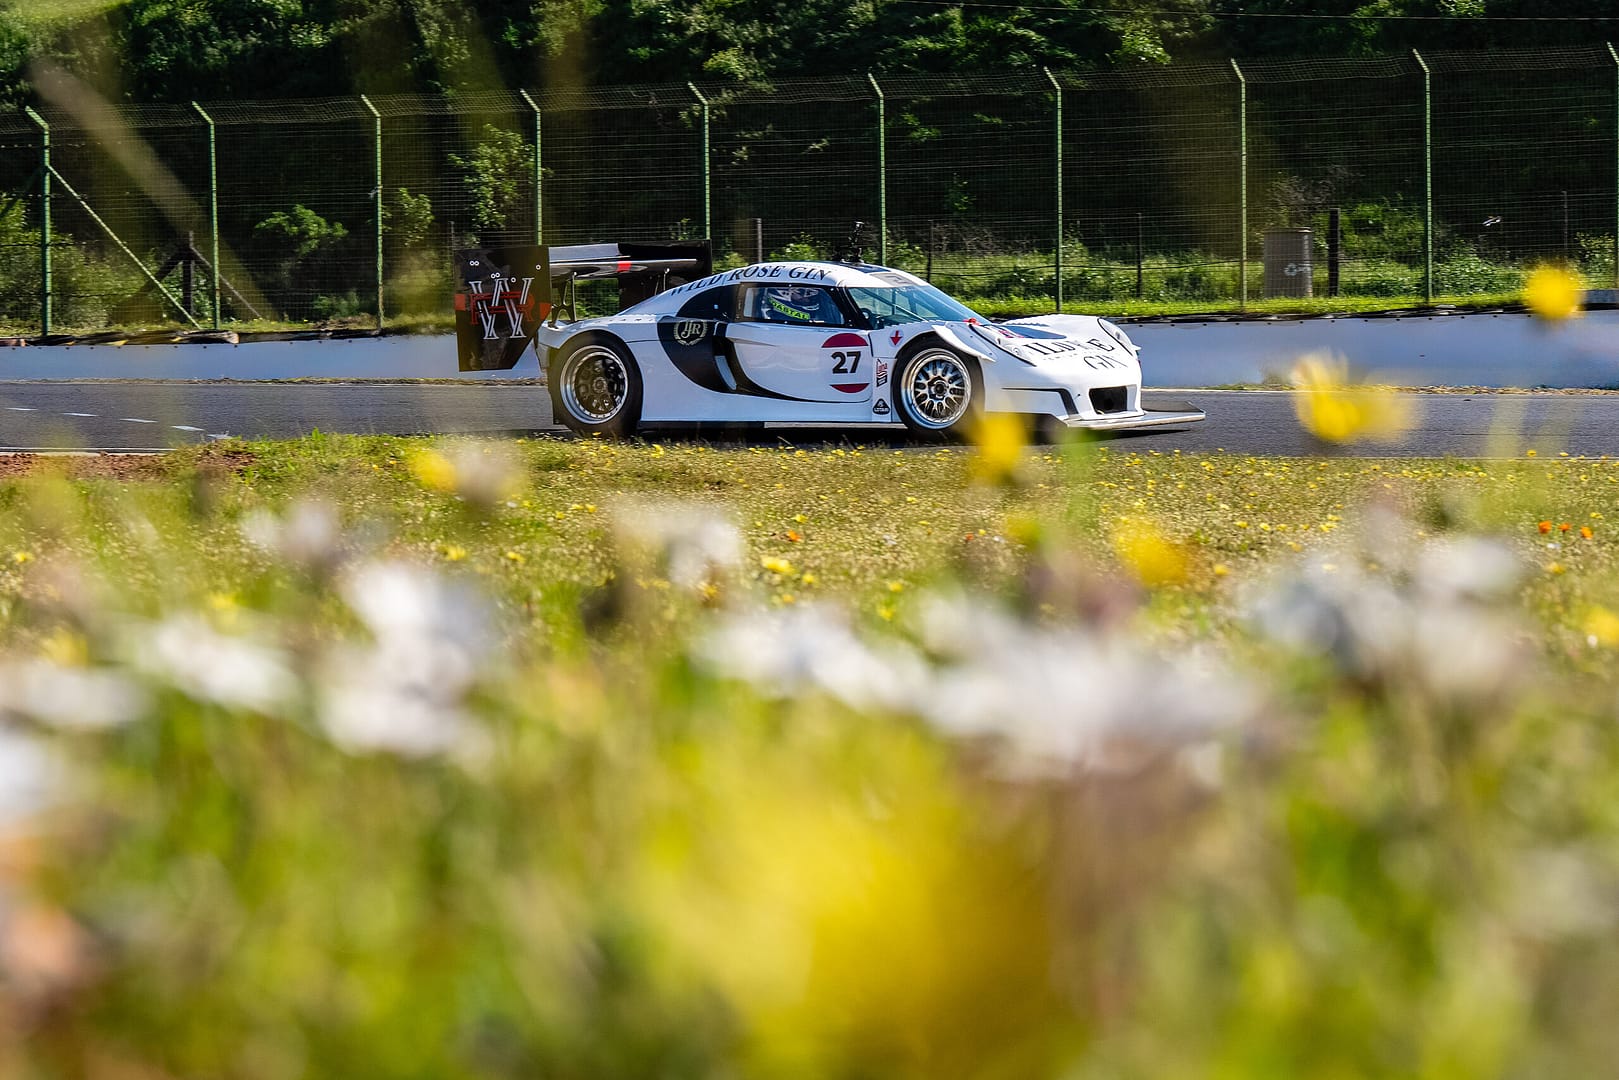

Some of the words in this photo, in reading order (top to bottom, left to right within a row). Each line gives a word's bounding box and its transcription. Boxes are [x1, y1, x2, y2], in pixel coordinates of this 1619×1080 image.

[671, 274, 723, 296] WILD
[728, 266, 785, 281] ROSE
[789, 266, 831, 281] GIN
[831, 351, 861, 374] 27
